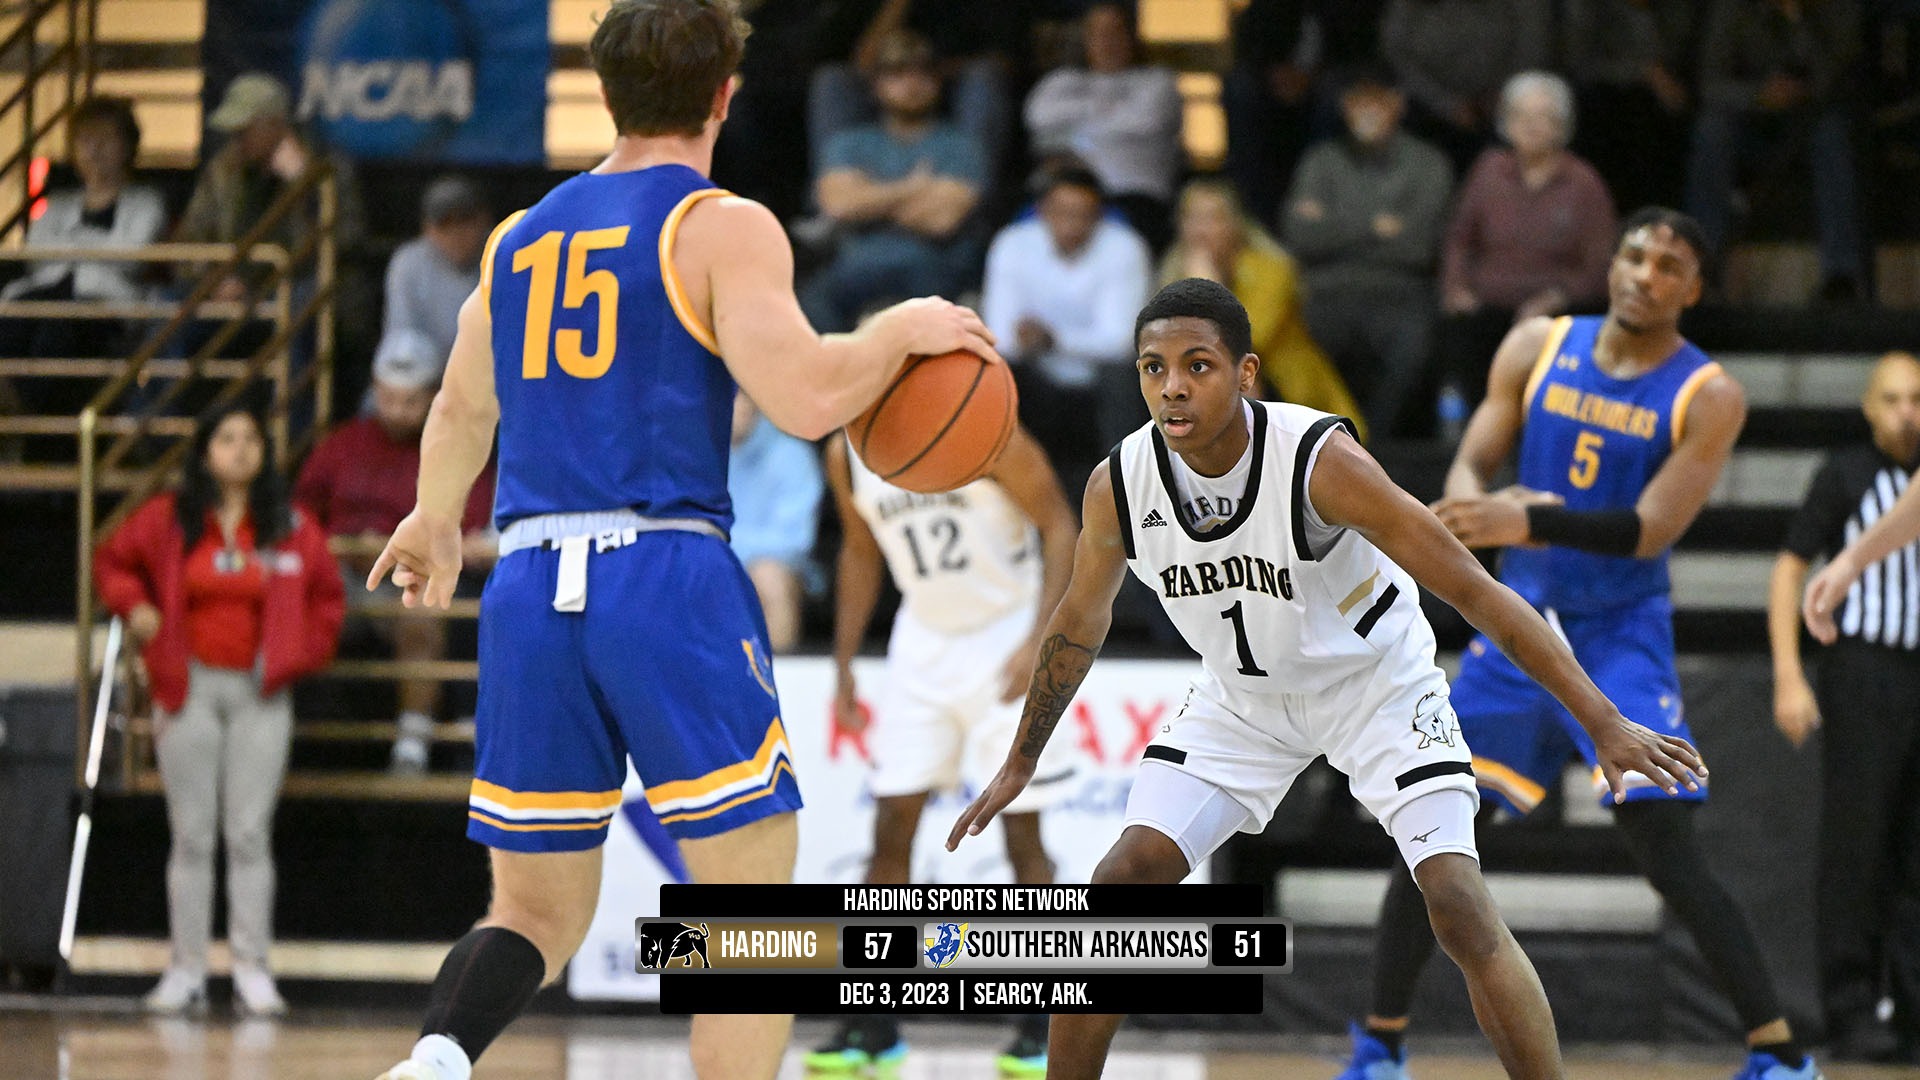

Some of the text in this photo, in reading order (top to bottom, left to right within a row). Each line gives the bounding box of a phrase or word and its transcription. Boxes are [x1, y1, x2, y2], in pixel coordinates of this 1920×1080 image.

[299, 60, 473, 122] NCAA
[512, 225, 631, 379] 15
[1569, 430, 1604, 489] 5
[905, 514, 969, 577] 12
[1141, 520, 1168, 529] adidas
[1159, 555, 1294, 601] HARDING
[1220, 599, 1269, 677] 1
